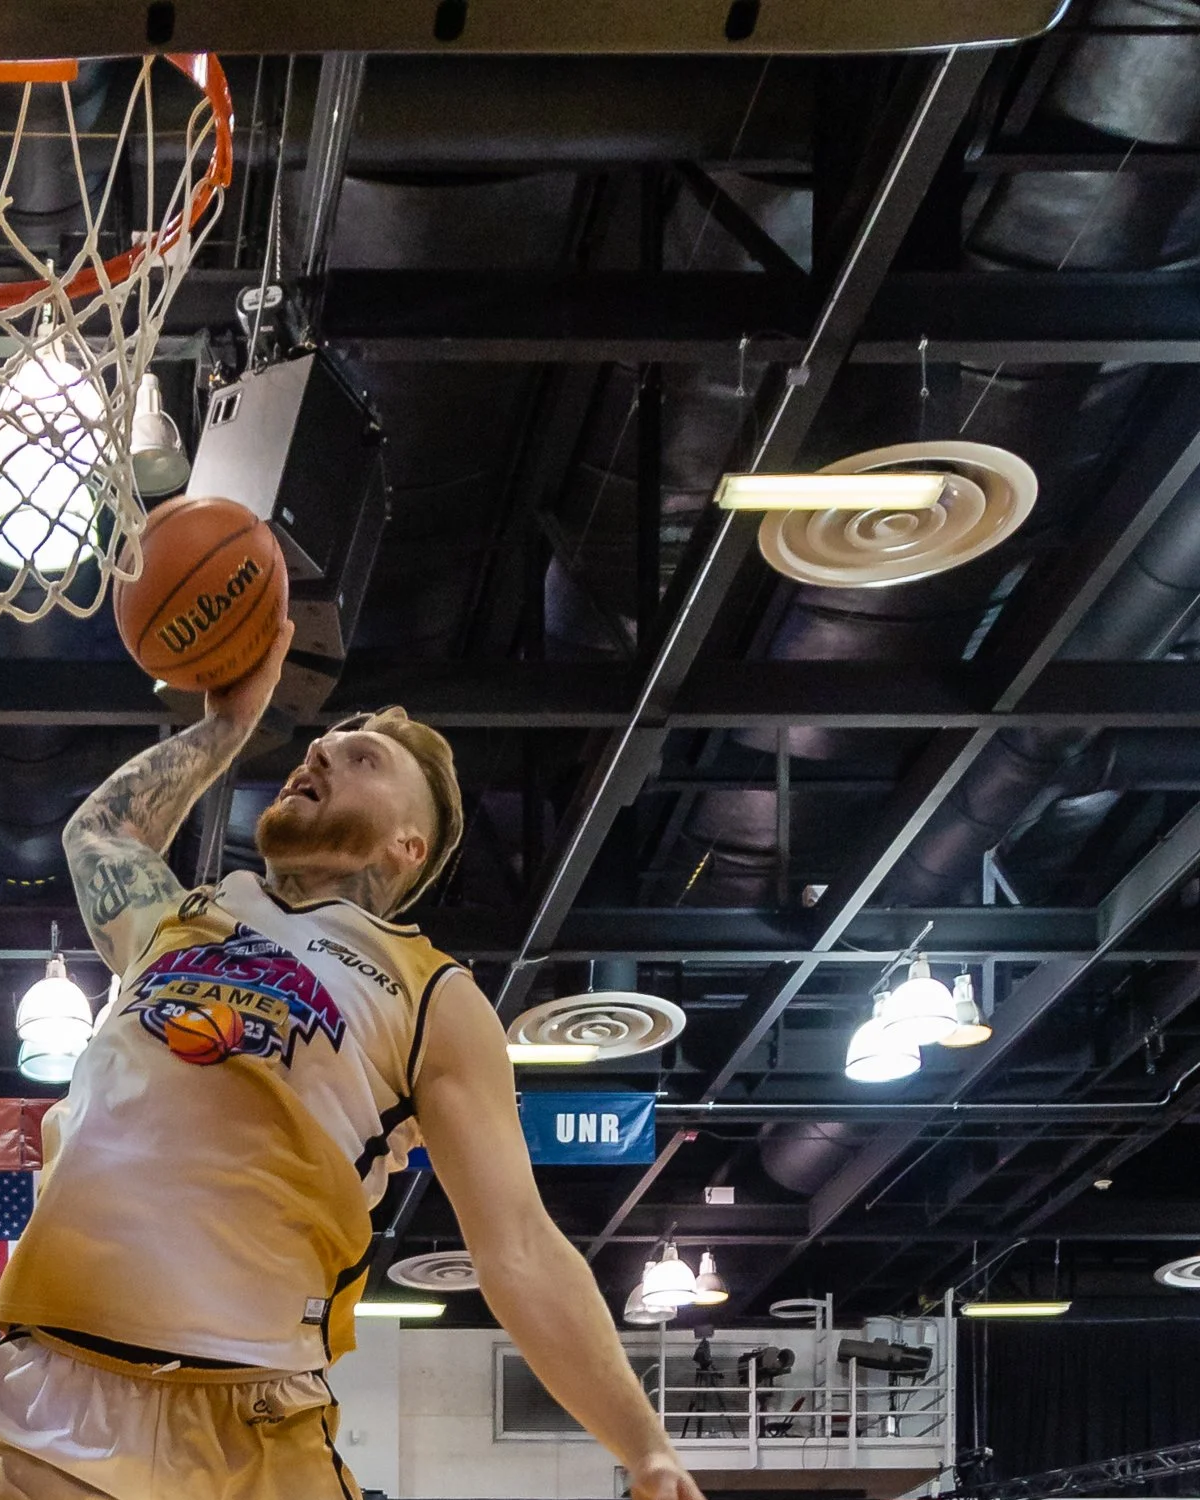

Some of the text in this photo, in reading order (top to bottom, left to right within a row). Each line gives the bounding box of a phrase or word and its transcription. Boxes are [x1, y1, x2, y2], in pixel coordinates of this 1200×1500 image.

[156, 556, 263, 654] Wilson
[176, 981, 273, 1015] GAME
[161, 1003, 265, 1039] 20 23
[556, 1113, 620, 1143] UNR
